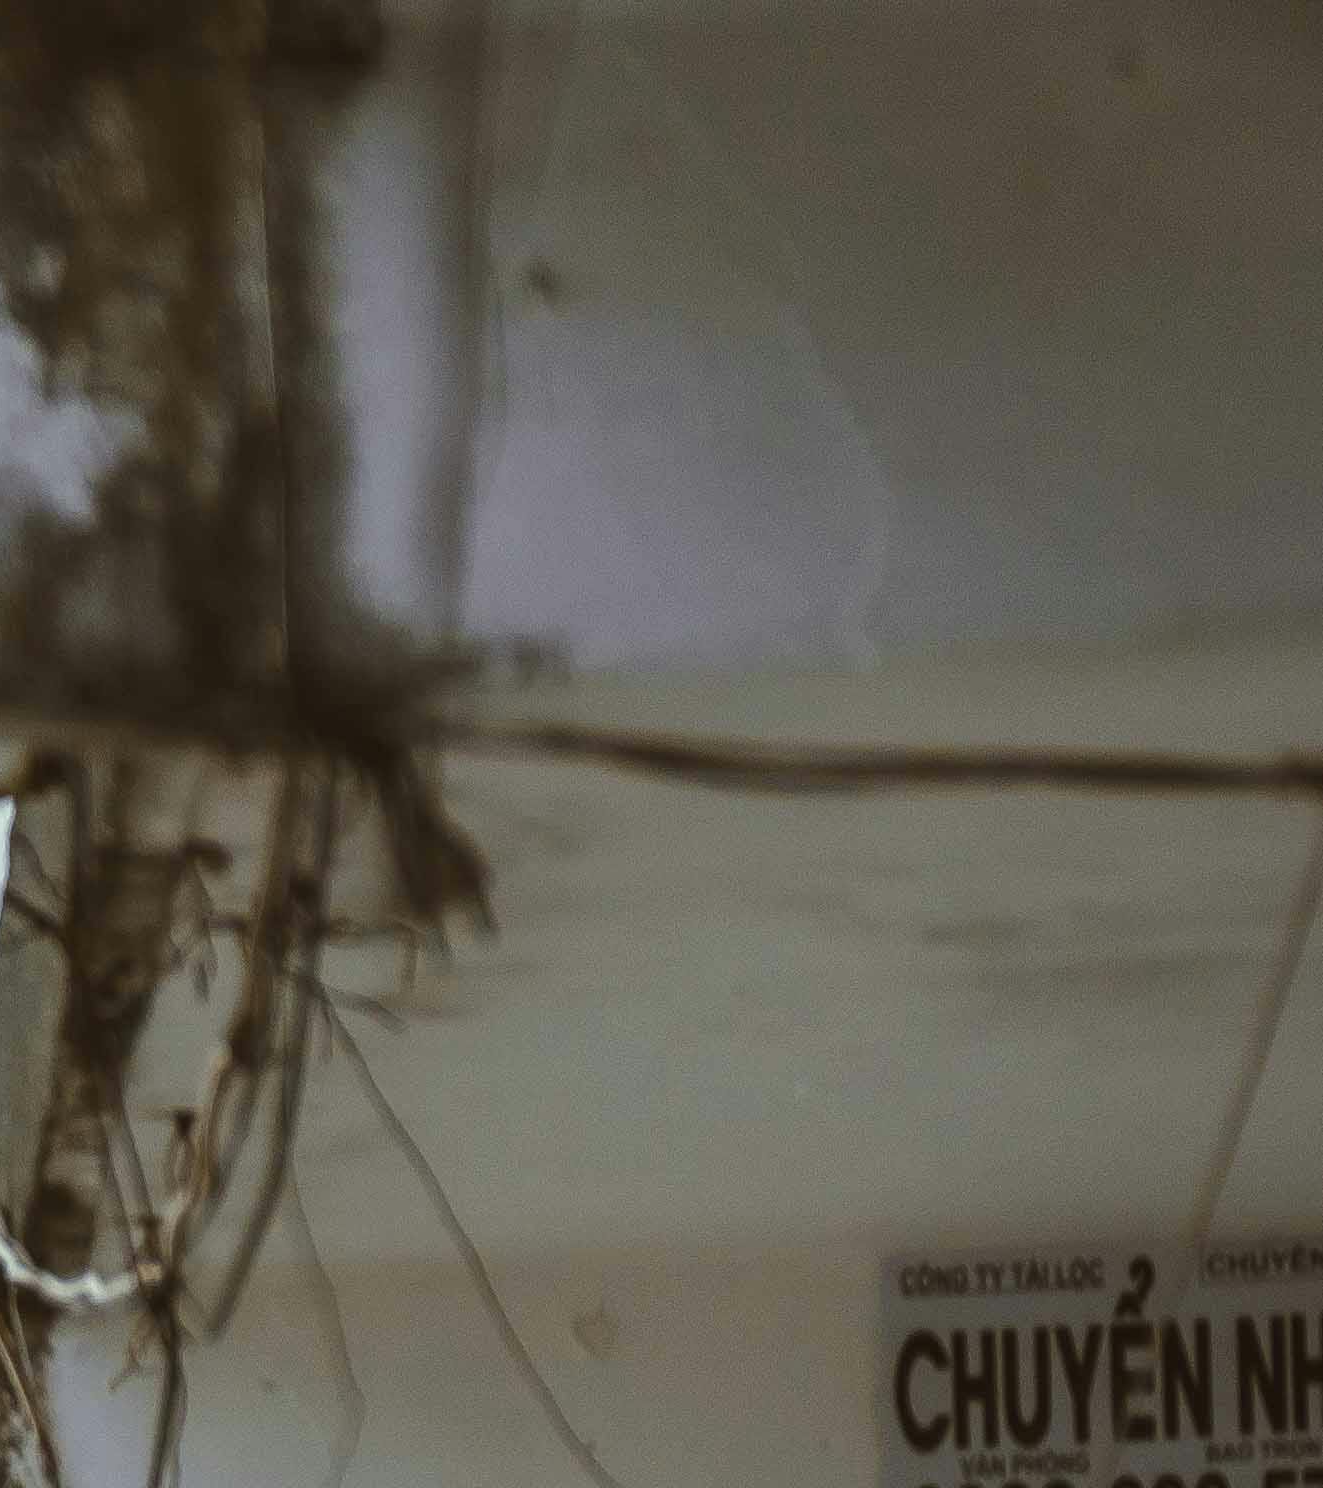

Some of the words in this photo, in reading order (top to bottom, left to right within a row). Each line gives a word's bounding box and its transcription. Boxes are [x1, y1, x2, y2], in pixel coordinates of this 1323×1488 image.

[976, 1261, 1004, 1295] TY
[894, 1254, 1214, 1453] CHUYỂN
[1235, 1311, 1323, 1436] NH
